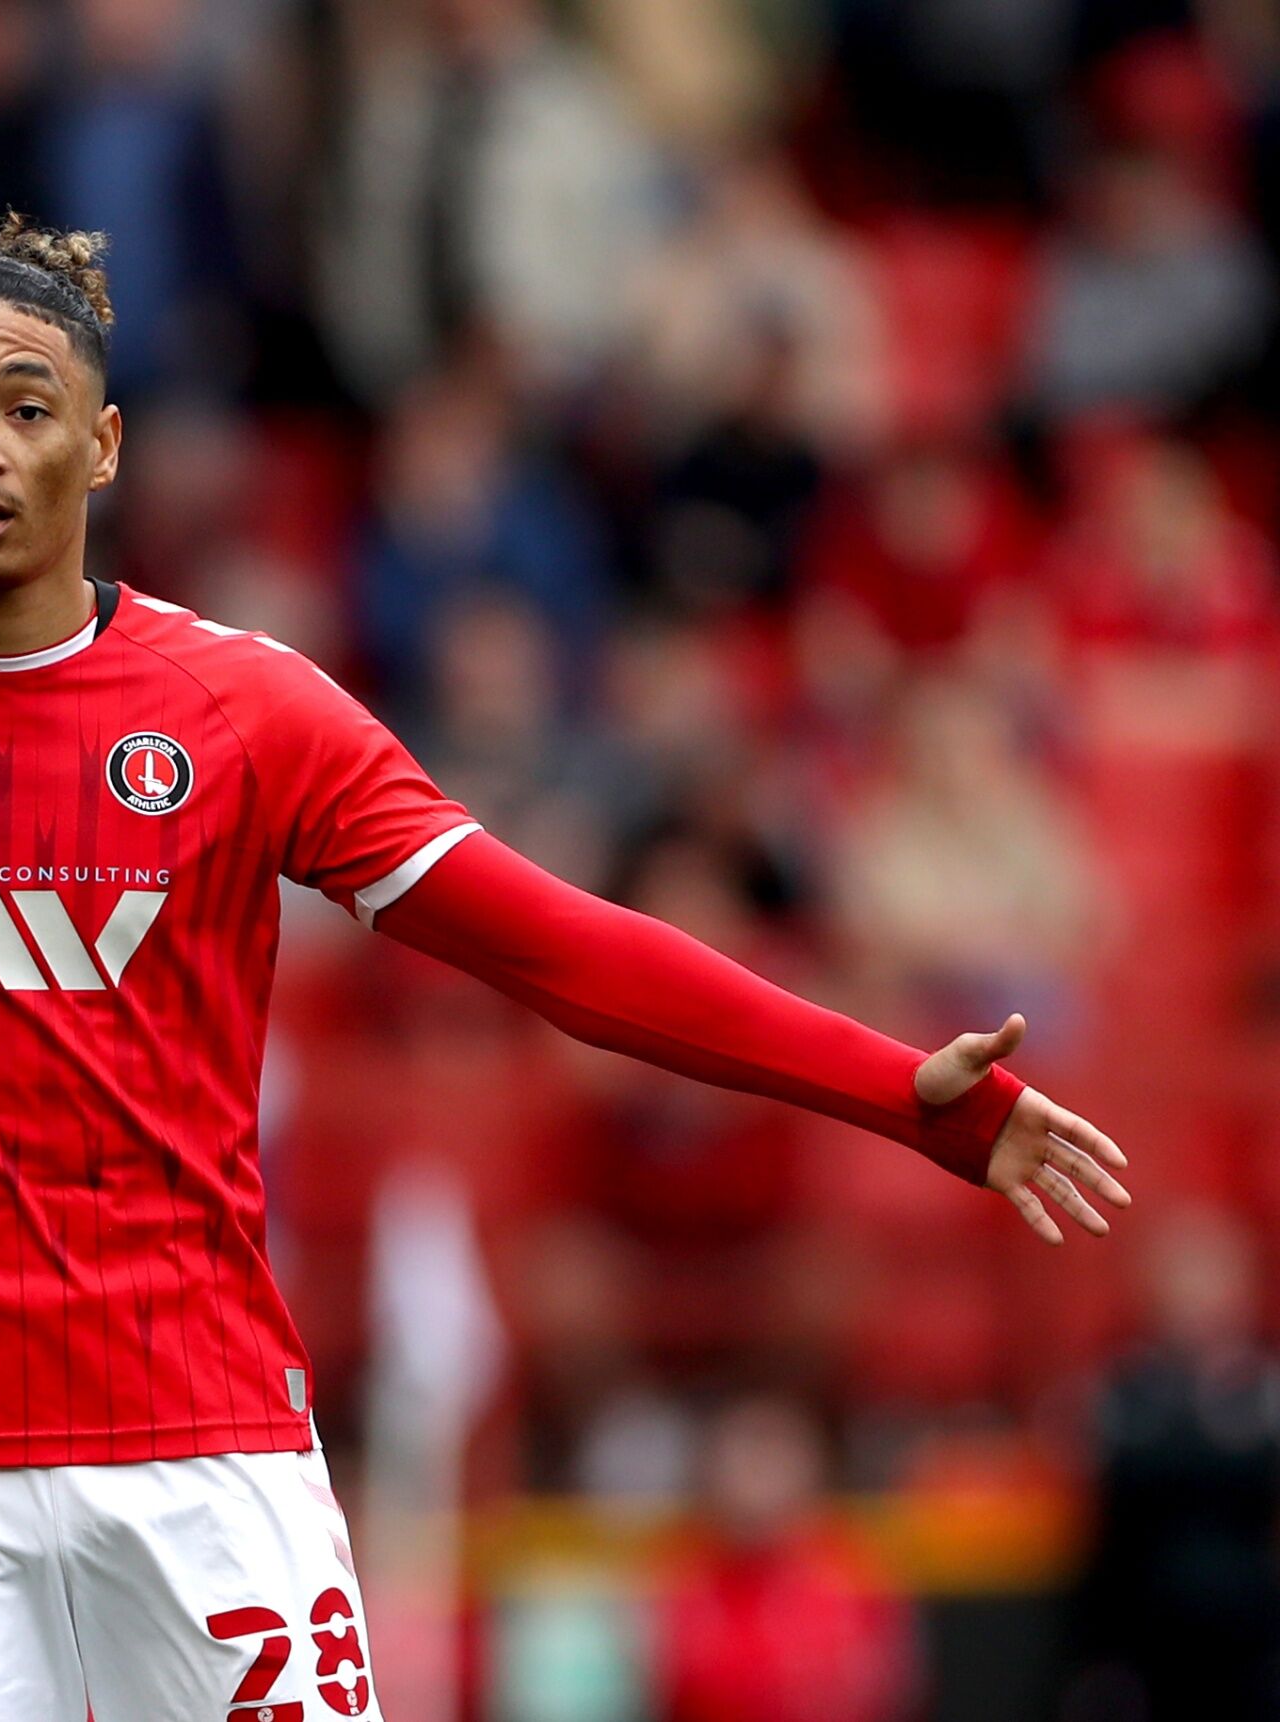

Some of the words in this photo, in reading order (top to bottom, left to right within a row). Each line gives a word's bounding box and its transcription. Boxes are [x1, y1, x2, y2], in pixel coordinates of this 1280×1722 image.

[122, 737, 178, 757] CHARLTON
[126, 794, 172, 810] ATHLETIC
[206, 1587, 369, 1722] 28
